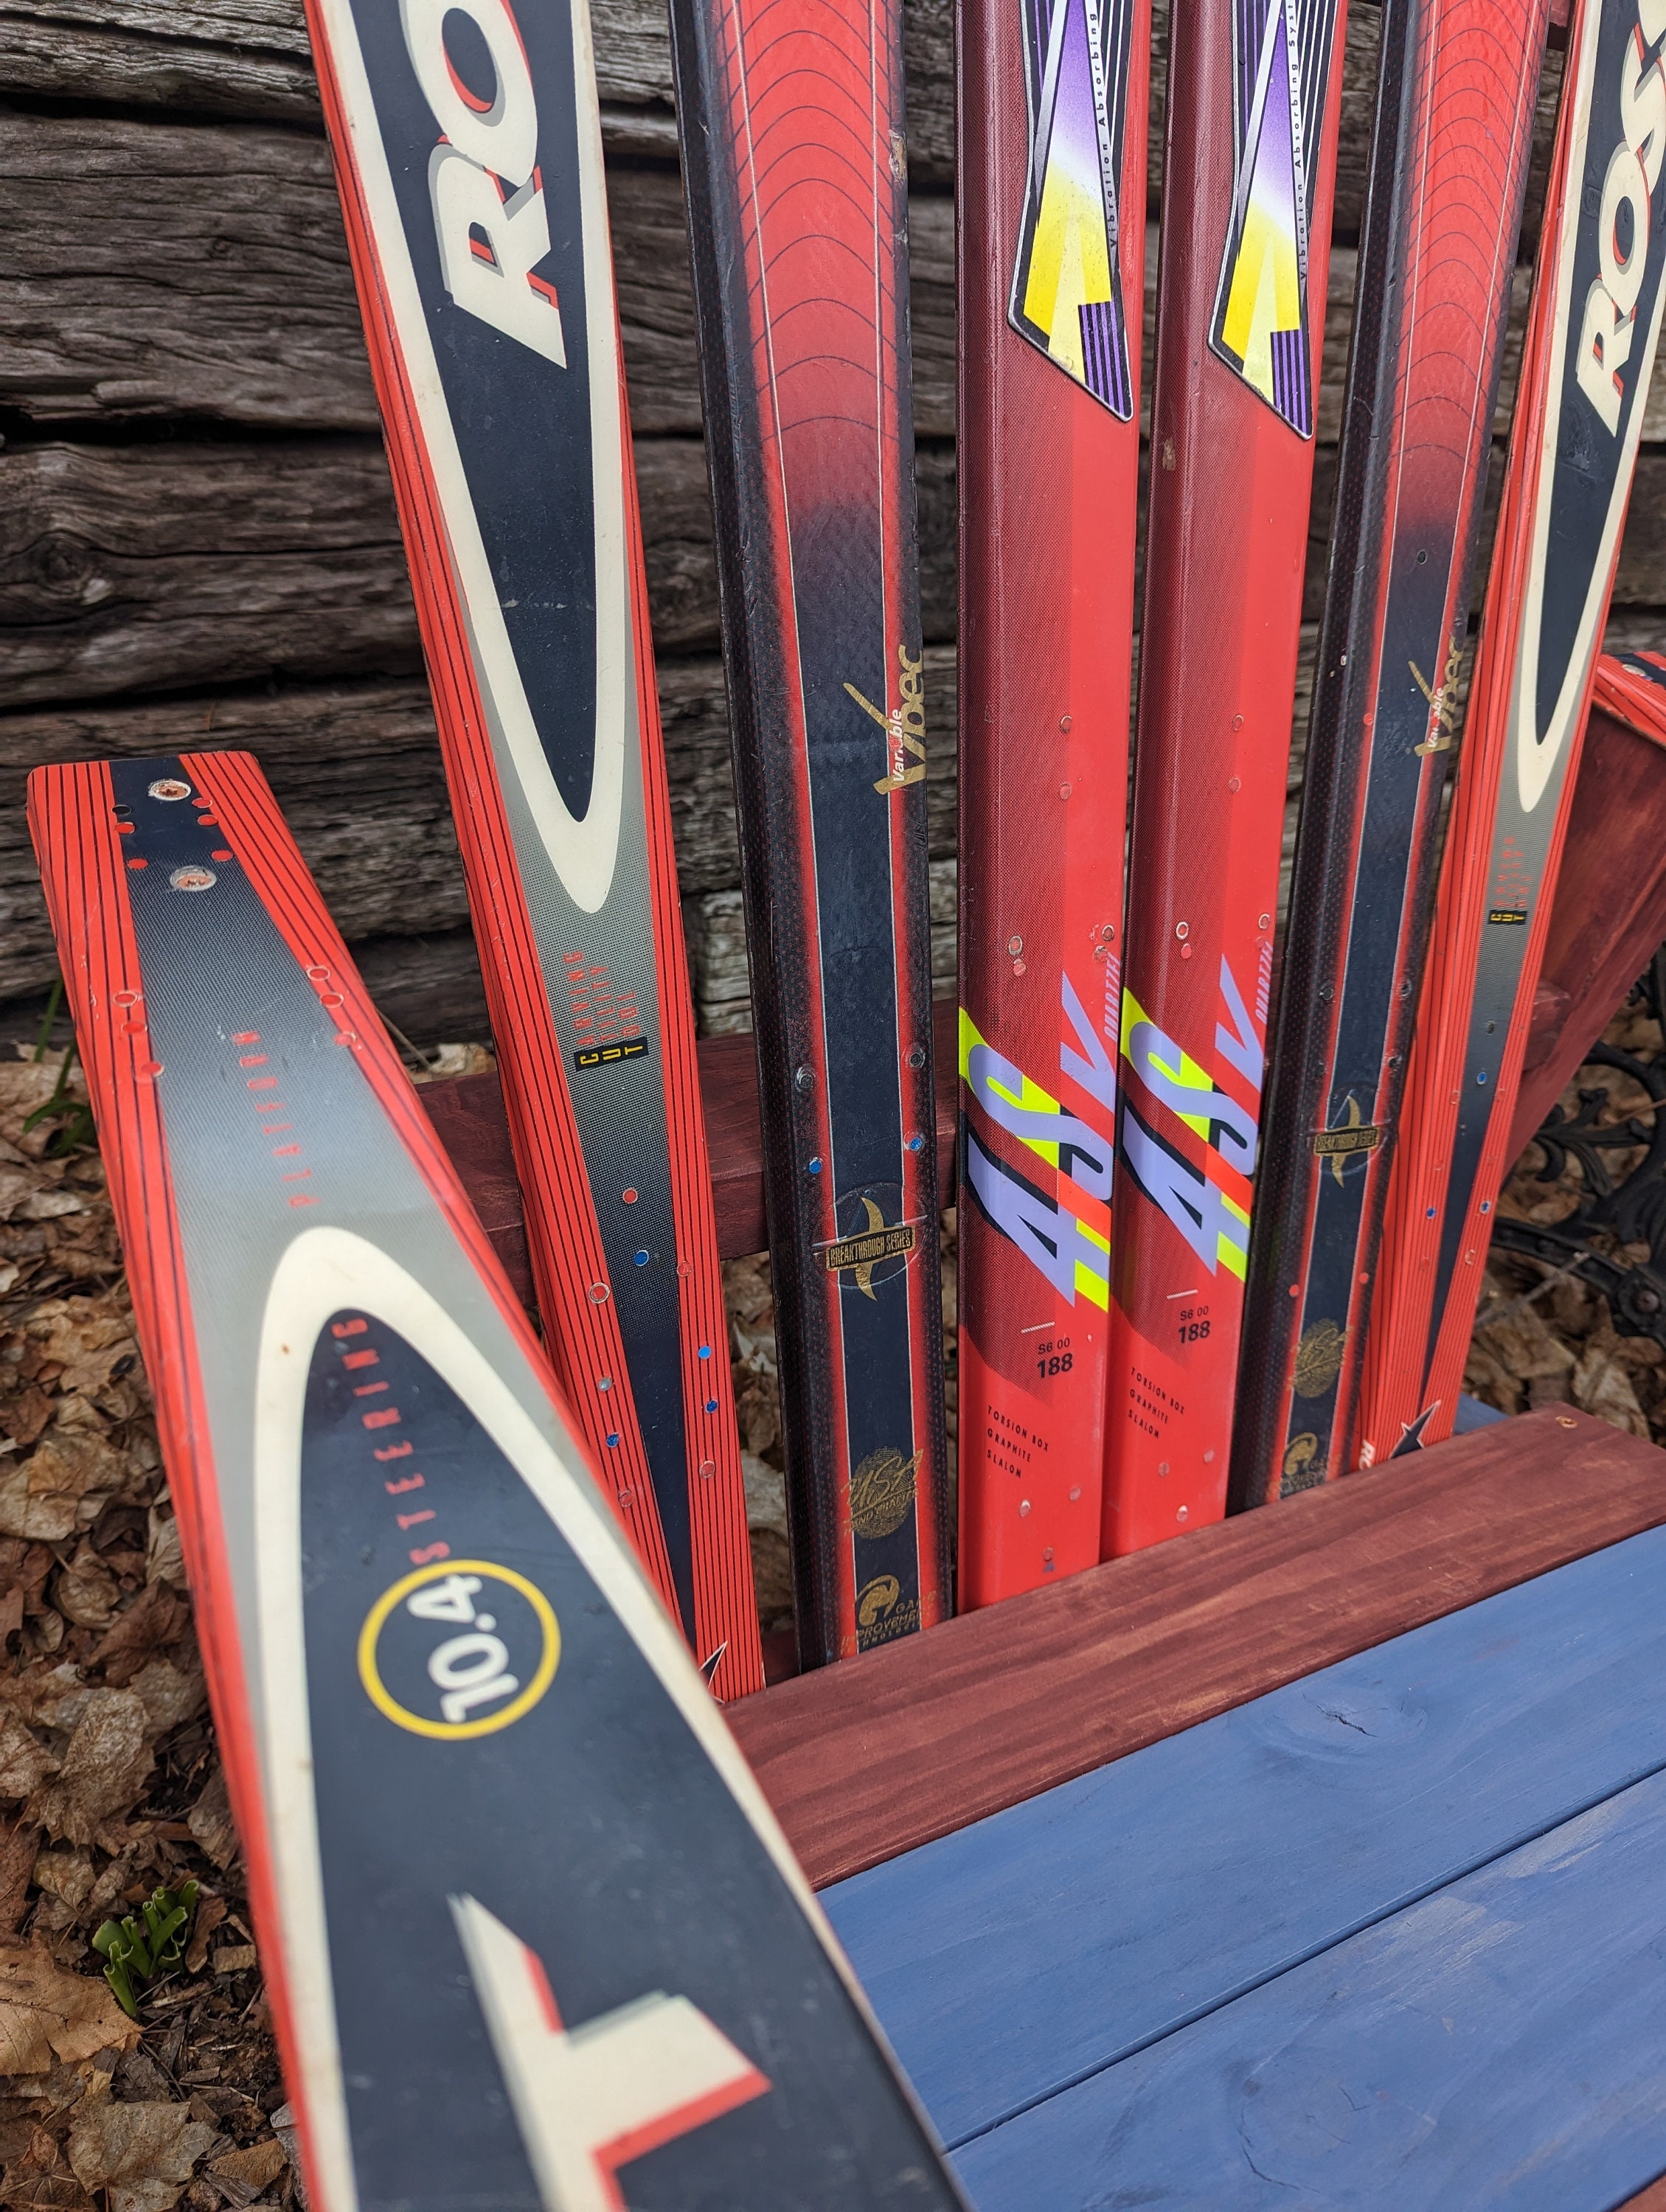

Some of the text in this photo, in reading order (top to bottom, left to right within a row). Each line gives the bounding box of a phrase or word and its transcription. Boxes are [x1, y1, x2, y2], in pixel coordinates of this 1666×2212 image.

[1090, 13, 1118, 248] Vibration Absorbing
[1291, 63, 1302, 168] Absorbing
[1296, 183, 1308, 281] Vibration
[830, 1228, 912, 1267] BREAKTHROUGH SERIES
[1179, 1321, 1211, 1343] 188
[1037, 1353, 1073, 1378] 188
[1130, 1388, 1169, 1425] GRAPHITE
[1131, 1367, 1185, 1415] TORSION BOX
[331, 1318, 451, 1565] STEERING
[987, 1405, 1049, 1452] TORSION BOX
[987, 1427, 1032, 1462] GRAPHITE
[1128, 1409, 1159, 1439] SLALOM
[987, 1450, 1021, 1478] SLALOM
[407, 1574, 519, 1723] 10.4
